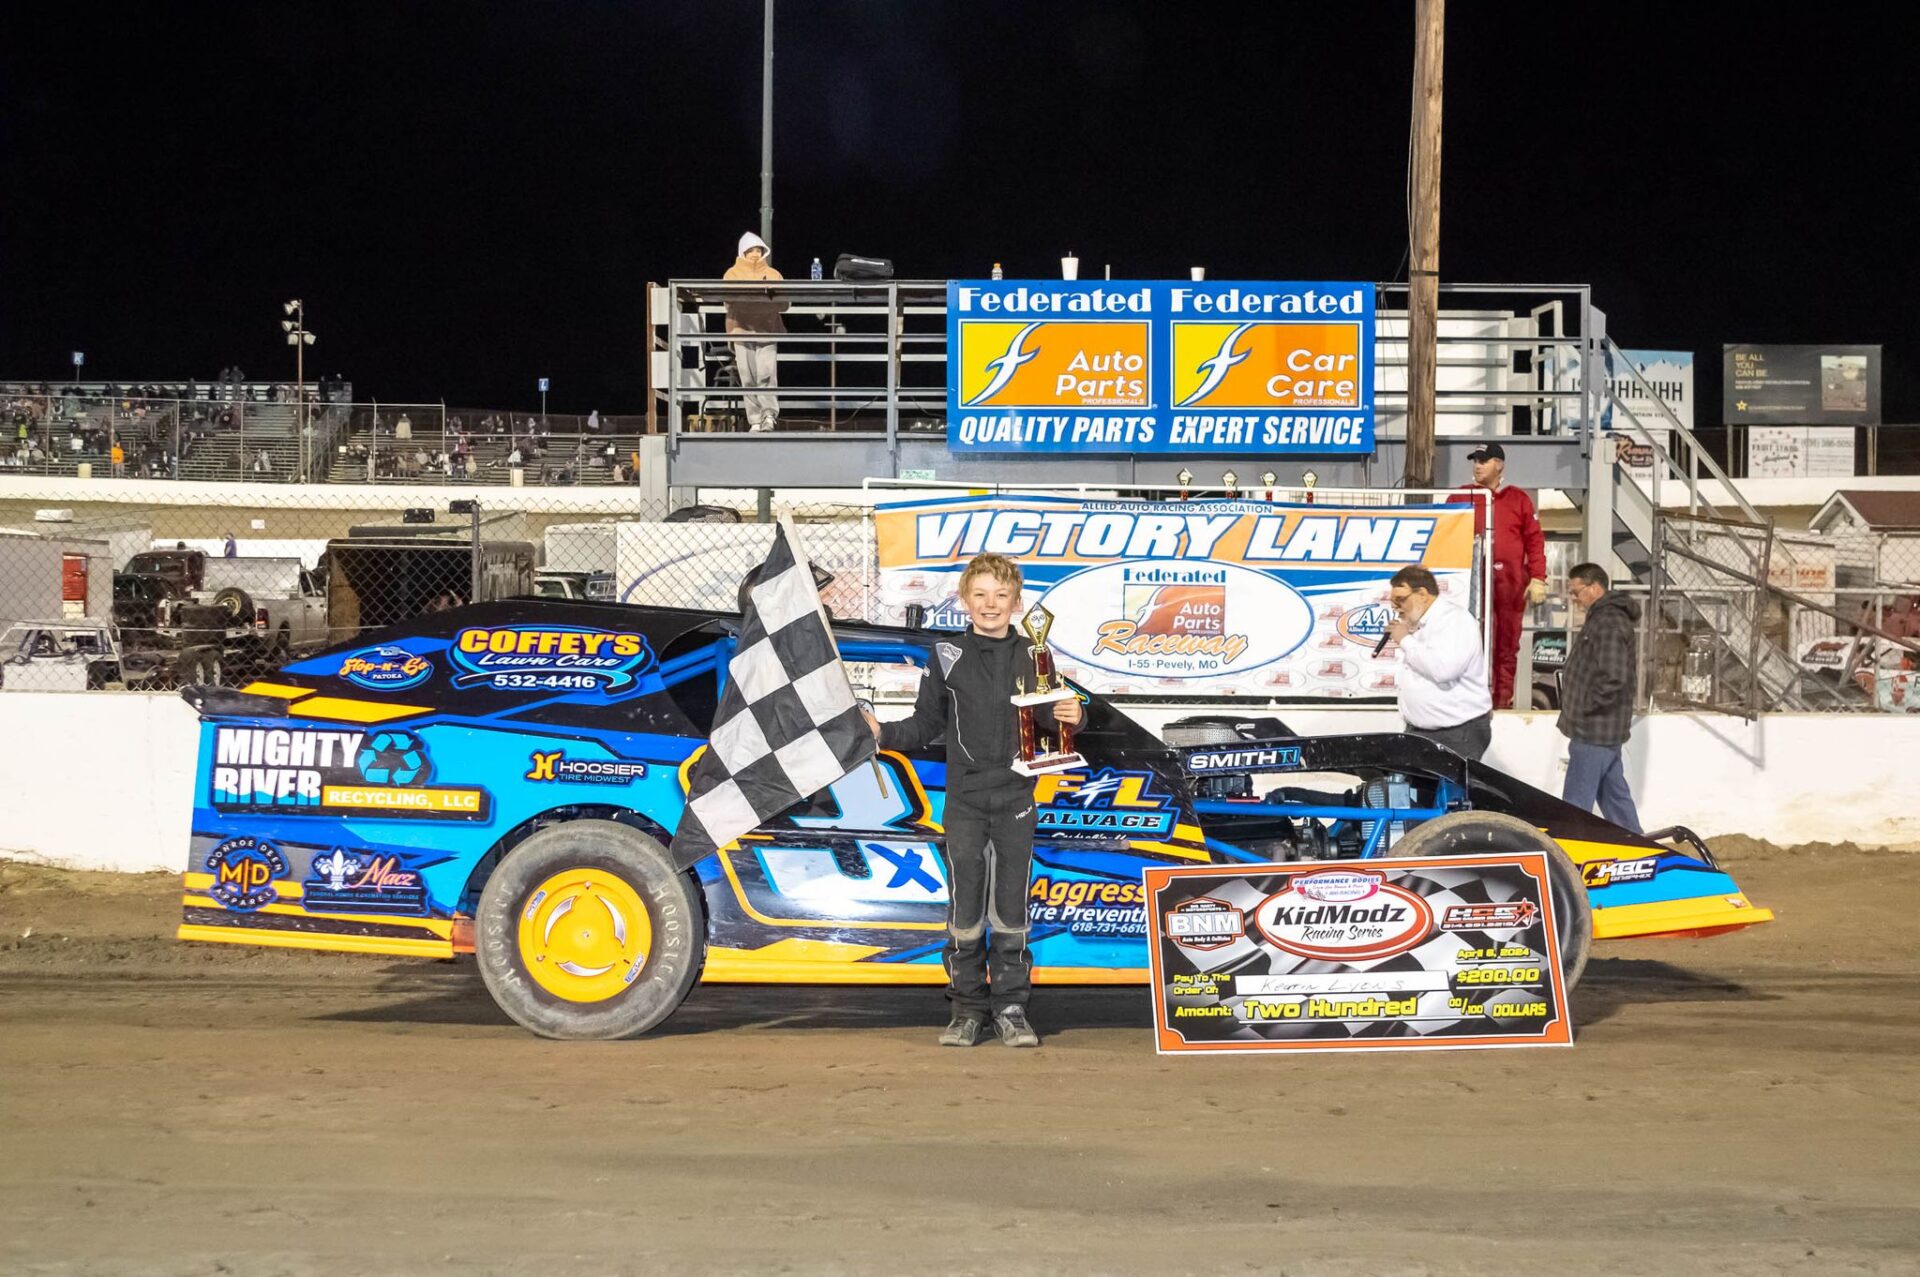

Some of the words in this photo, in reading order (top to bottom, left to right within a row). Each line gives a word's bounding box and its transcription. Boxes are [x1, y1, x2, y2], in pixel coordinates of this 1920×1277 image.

[958, 287, 1152, 312] Federated
[1170, 288, 1363, 313] Federated
[1067, 349, 1144, 372] Auto
[1286, 349, 1355, 372] Car
[1055, 375, 1143, 397] Parts
[1266, 374, 1354, 397] Care
[1082, 397, 1145, 405] PROFESSIONALS
[958, 416, 1071, 444] QUALITY
[1072, 416, 1156, 443] PARTS
[1170, 416, 1259, 443] EXPERT
[1263, 416, 1365, 444] SERVICE
[1081, 502, 1117, 511] ALLIED
[1120, 503, 1150, 511] AUTO
[1153, 503, 1195, 512] RACING
[1198, 503, 1273, 514] ASSOCIATION
[915, 512, 1238, 561] VICTORY
[1244, 516, 1436, 562] LANE
[1123, 568, 1226, 583] Federated
[1180, 602, 1221, 615] Auto
[1173, 616, 1221, 630] Parts
[459, 630, 642, 655] COFFEY'S
[1092, 619, 1248, 665] Raceway
[478, 654, 553, 667] Lawn
[555, 655, 622, 668] Care
[1128, 659, 1150, 669] I-55
[1156, 660, 1195, 671] Pevely,
[1199, 661, 1218, 669] MO
[494, 674, 596, 688] 532-4416
[217, 729, 365, 767] MIGHTY
[560, 761, 644, 776] HOOSIER
[1190, 751, 1277, 769] SMITH
[215, 768, 321, 806] RIVER
[560, 773, 581, 781] TIRE
[584, 775, 631, 783] MIDWEST
[329, 791, 433, 809] RECYCLING,
[443, 795, 476, 808] LLC
[1039, 812, 1161, 829] ALVAGE
[208, 839, 255, 867] MONROE
[259, 844, 283, 871] DEEN
[215, 888, 273, 906] APPAREL
[1030, 904, 1057, 920] ire
[1272, 904, 1407, 926] KidModz
[1171, 914, 1240, 934] BNM
[1301, 925, 1346, 942] Racing
[1347, 925, 1383, 940] Series
[1456, 949, 1483, 959] April
[1500, 948, 1530, 957] 2024
[1173, 974, 1194, 986] Pay
[1195, 974, 1209, 983] To
[1211, 973, 1231, 982] The
[1456, 968, 1540, 984] $200.00
[1173, 986, 1203, 995] Order
[1175, 1005, 1234, 1018] Amount:
[1243, 999, 1301, 1019] Two
[1307, 996, 1418, 1018] Hundred
[1492, 1003, 1547, 1017] DOLLARS
